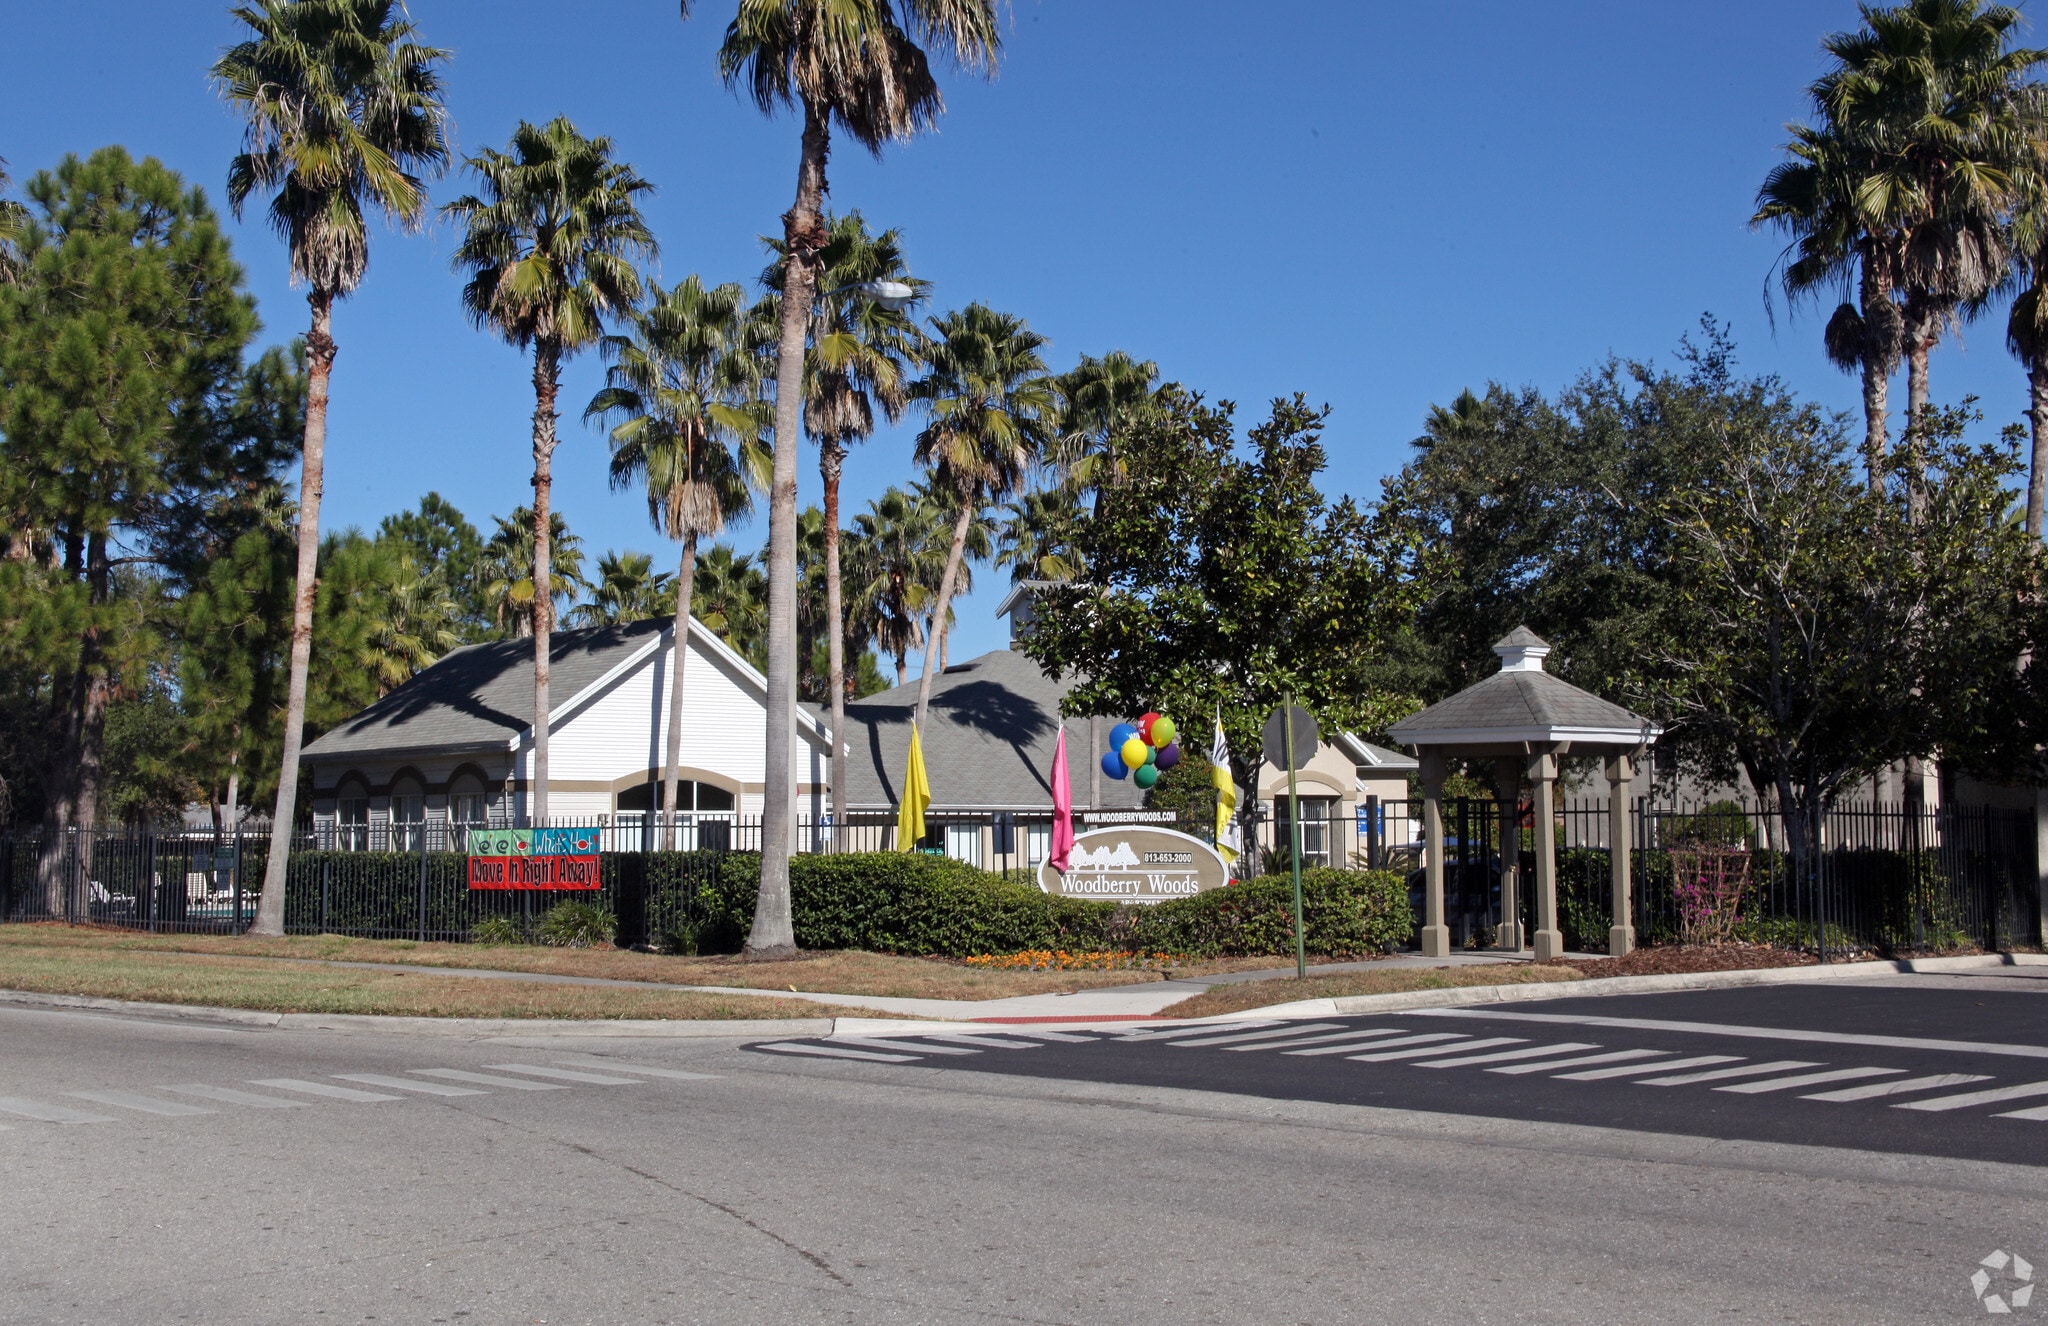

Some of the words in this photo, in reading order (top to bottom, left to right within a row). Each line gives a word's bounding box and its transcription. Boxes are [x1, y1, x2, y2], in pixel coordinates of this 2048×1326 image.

[1083, 811, 1176, 823] WWW.WOODBERRYWOODS.COM
[535, 830, 567, 854] What's
[569, 831, 598, 853] Hot!
[1144, 852, 1192, 863] 813-653-2000
[472, 857, 503, 883] Move
[508, 856, 519, 883] In
[521, 857, 555, 887] Right
[558, 856, 598, 887] Away!
[1059, 874, 1141, 897] Woodberry
[1147, 874, 1199, 893] Woods
